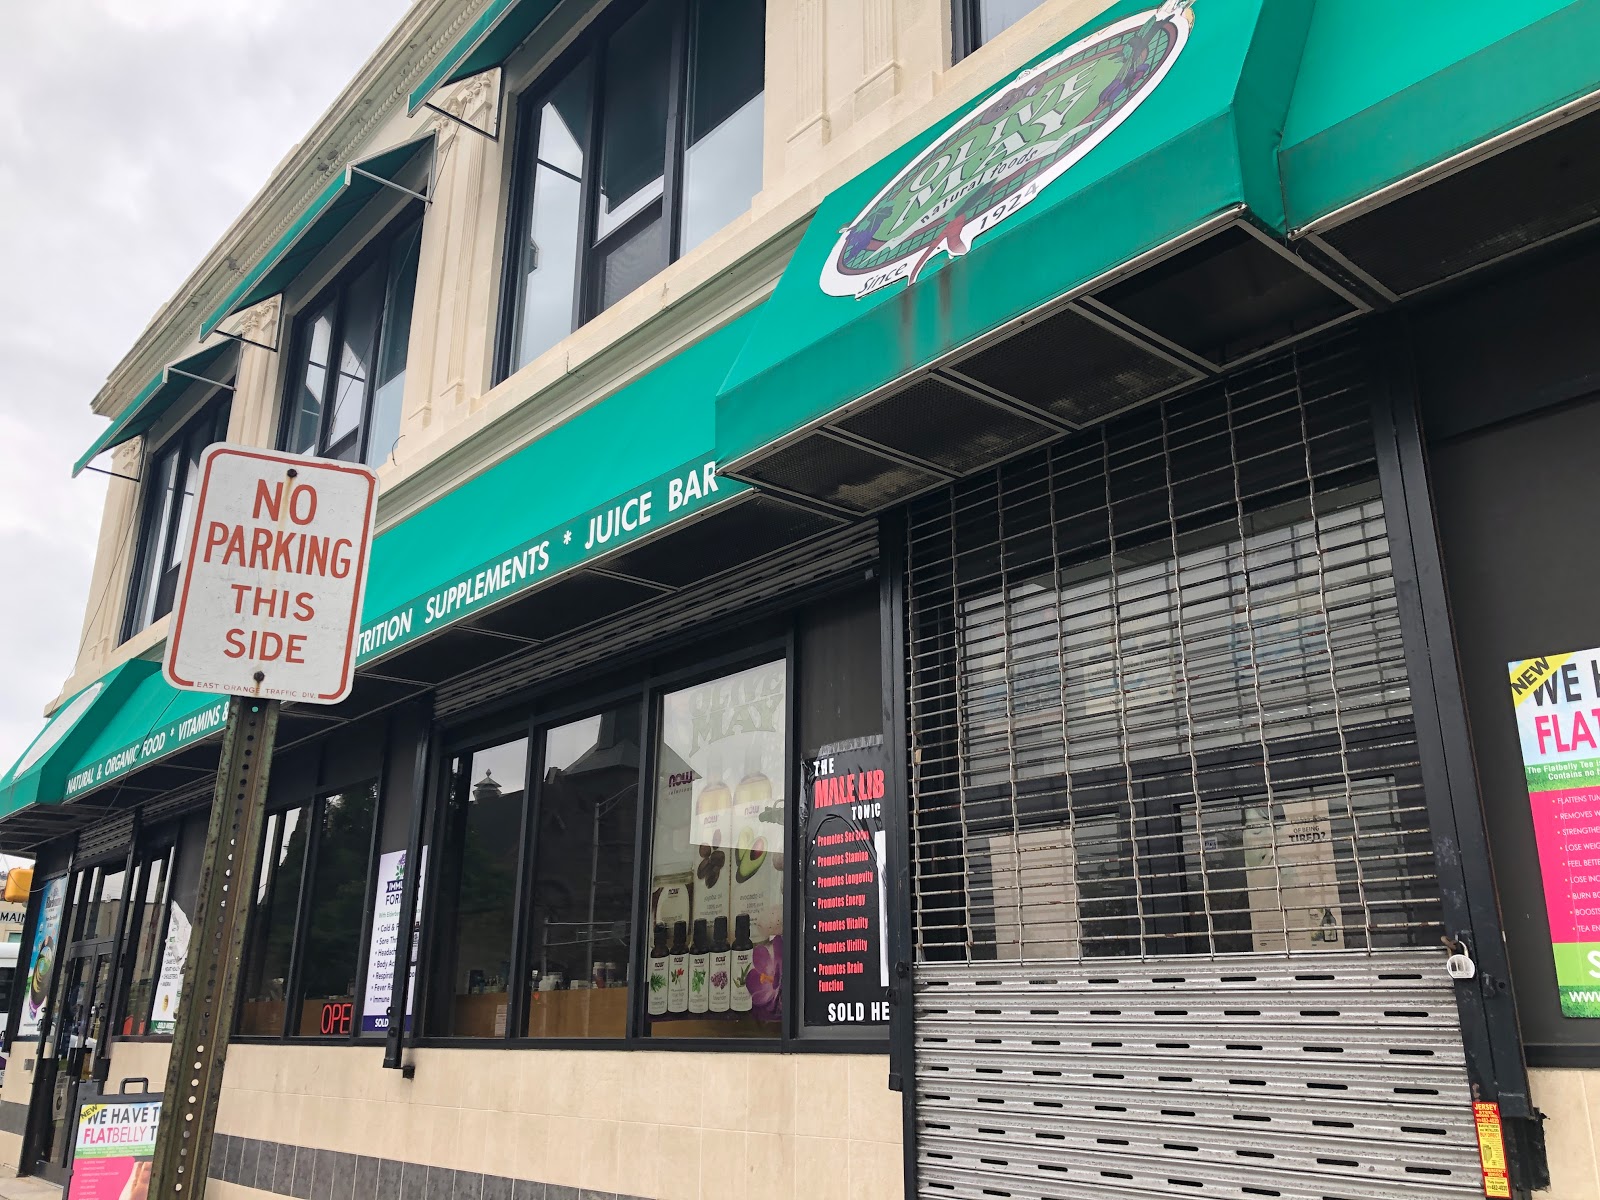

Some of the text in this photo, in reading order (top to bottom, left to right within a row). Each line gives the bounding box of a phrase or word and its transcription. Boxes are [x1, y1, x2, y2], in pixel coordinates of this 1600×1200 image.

[908, 60, 1101, 194] OLIVE
[887, 83, 1094, 235] MAY
[990, 147, 1039, 179] foods
[858, 181, 1039, 294] Since 1924
[252, 478, 318, 526] NO
[204, 521, 353, 579] PARKING
[425, 540, 549, 624] SUPPLEMENTS
[584, 491, 652, 550] JUICE
[668, 461, 719, 512] BAR
[231, 583, 315, 622] THIS
[223, 628, 308, 664] SIDE
[1510, 656, 1550, 695] NEW
[196, 681, 220, 690] EAST
[265, 688, 297, 698] TRAFFIC
[302, 691, 316, 699] DIV.
[1533, 663, 1582, 706] WE
[688, 693, 784, 758] MAY
[66, 701, 230, 795] NATURAL & ORGANIC FOOD VITAMINS &
[813, 757, 835, 776] THE
[1543, 763, 1577, 773] Flatbelly
[1580, 761, 1593, 769] Tea
[1548, 771, 1582, 780] Contains
[814, 769, 885, 809] MALE LIB
[1557, 795, 1587, 804] FLATTENS
[851, 802, 881, 821] TONIC
[1560, 810, 1592, 820] REMOVES
[1288, 831, 1326, 843] TIRED?
[1302, 825, 1320, 833] BEING
[817, 833, 844, 847] Promotes
[817, 850, 869, 867] Promotes Stamina
[817, 870, 874, 888] Promotes Longevity
[385, 893, 400, 905] FOR
[817, 894, 866, 909] Promotes Energy
[1572, 892, 1591, 900] BURN
[380, 924, 390, 932] Cold
[818, 916, 869, 933] Promotes Vitality
[379, 938, 389, 946] Sore
[818, 938, 868, 954] Promotes Virility
[376, 960, 388, 970] Body
[818, 961, 864, 976] Promotes Brain
[374, 983, 387, 991] Fever
[818, 979, 844, 992] Function
[321, 1003, 354, 1034] OPE
[828, 1002, 865, 1022] SOLD
[375, 1018, 389, 1028] SOLD
[80, 1104, 98, 1119] NEW
[1475, 1103, 1497, 1111] JERSEY
[88, 1108, 107, 1125] WE
[110, 1107, 149, 1125] HAVE
[83, 1125, 147, 1145] FLATBELLY
